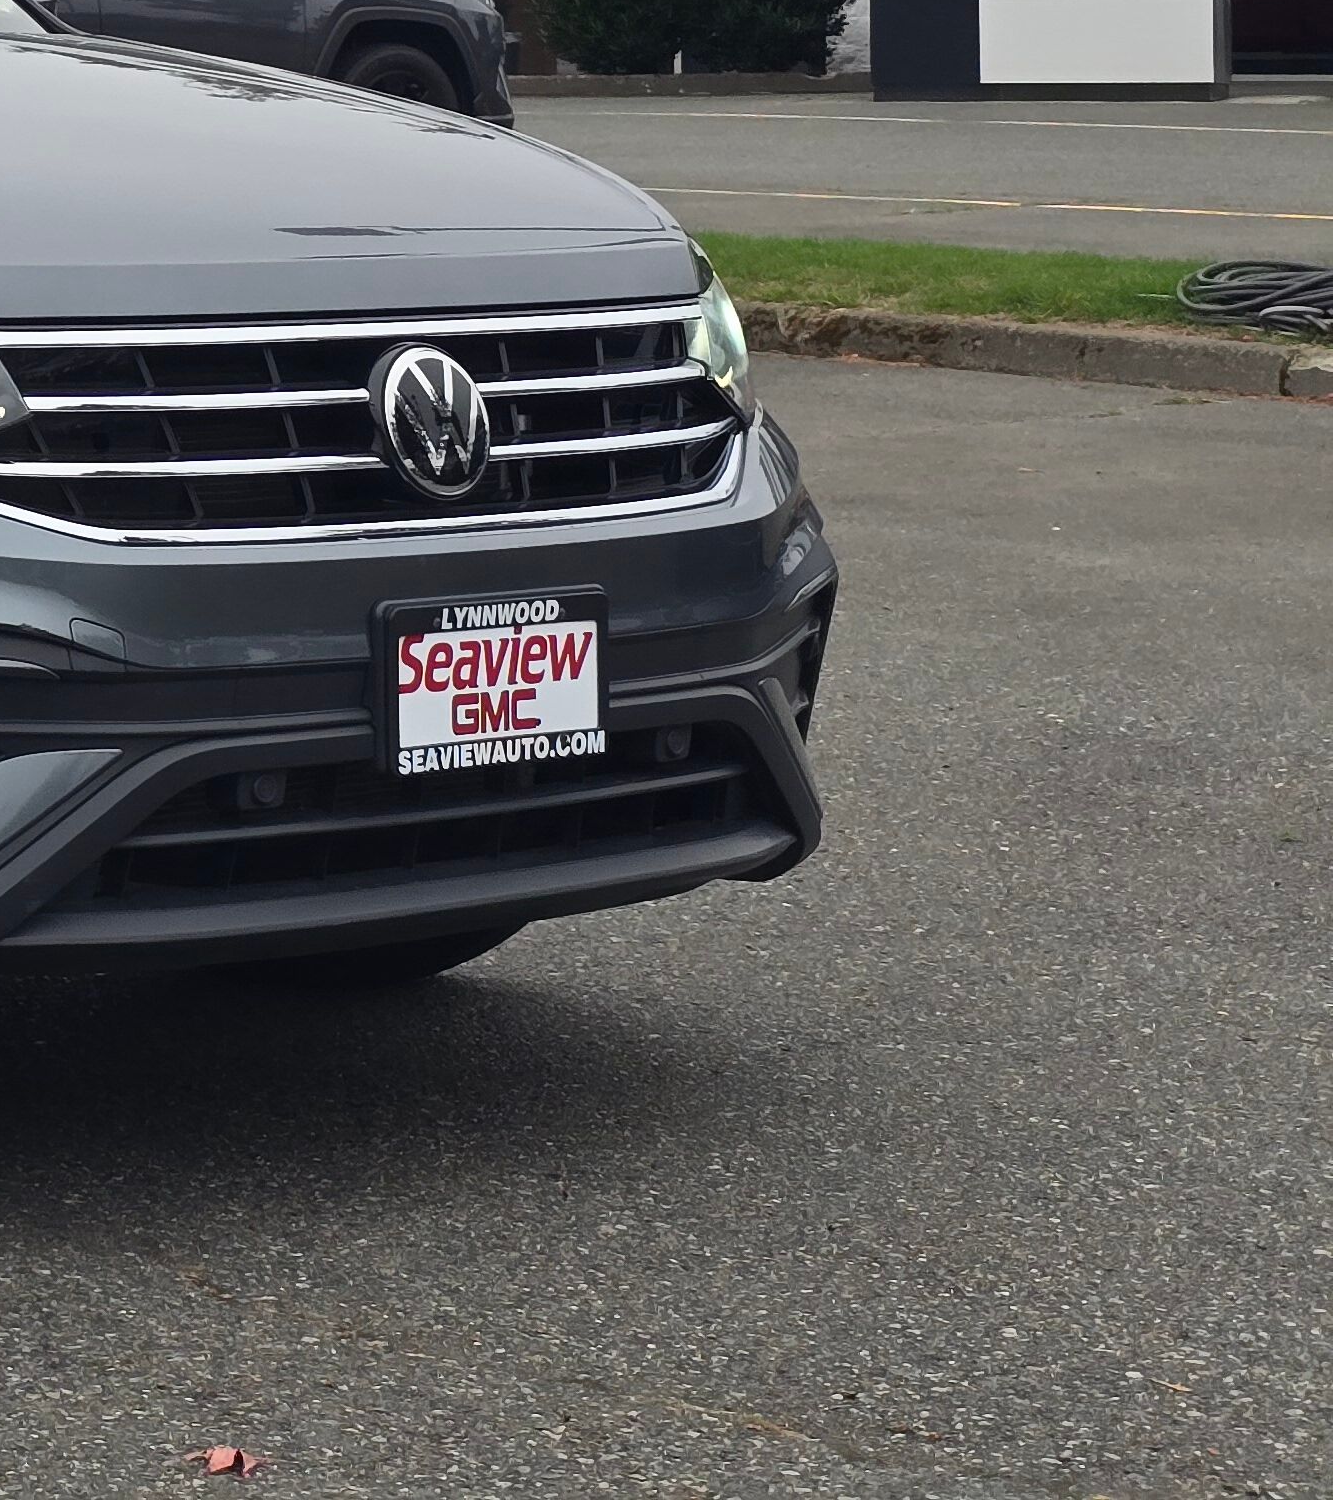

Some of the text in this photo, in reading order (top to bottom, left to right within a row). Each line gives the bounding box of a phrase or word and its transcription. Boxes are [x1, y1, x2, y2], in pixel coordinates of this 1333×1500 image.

[441, 599, 560, 630] LYNNWOOD
[398, 626, 593, 695] Seaview
[451, 688, 541, 736] GMC
[398, 730, 606, 775] SEAVIEWAUTO.COM
